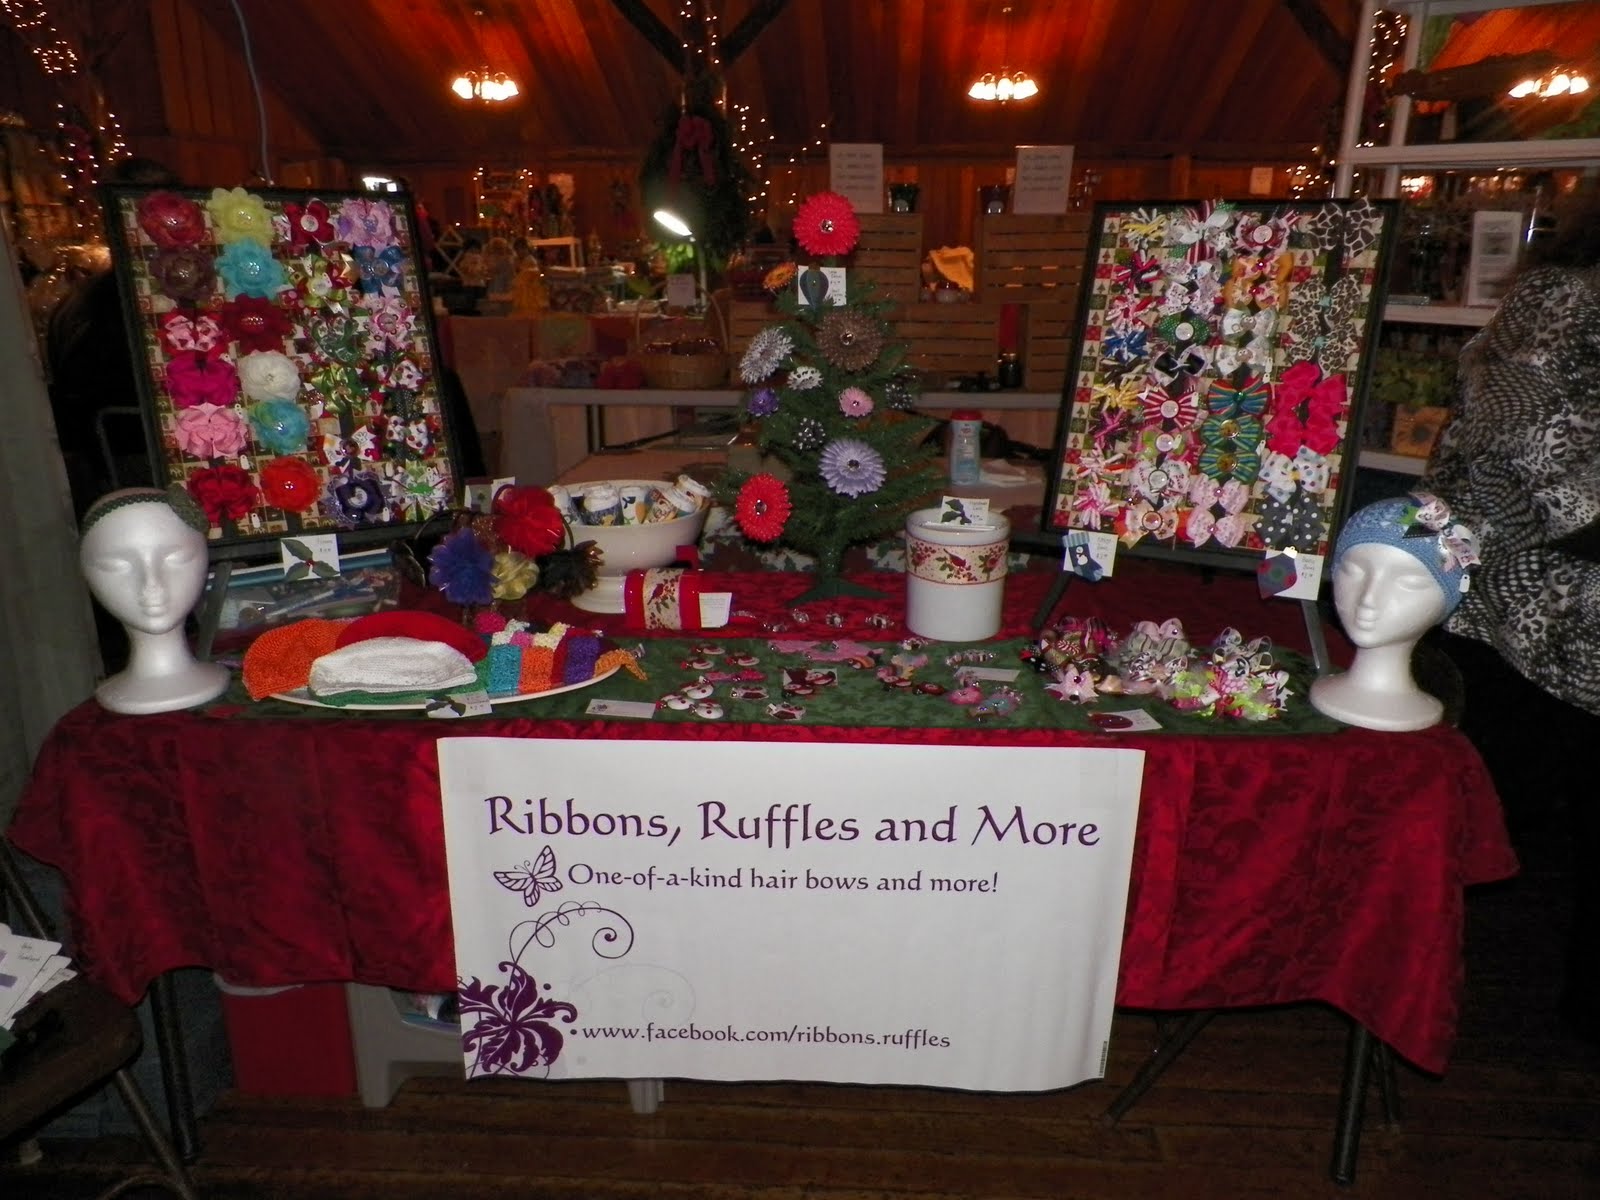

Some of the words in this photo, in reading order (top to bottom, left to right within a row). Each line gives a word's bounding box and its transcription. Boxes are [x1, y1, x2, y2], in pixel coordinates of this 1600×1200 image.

[484, 795, 681, 848] Ribbons,
[697, 801, 860, 850] Ruffles
[875, 805, 958, 843] and
[971, 805, 1100, 847] More
[568, 864, 742, 891] One-of-a-kind
[750, 868, 798, 889] hair
[805, 868, 868, 890] bows
[877, 870, 922, 892] and
[930, 871, 998, 893] more!
[583, 1022, 951, 1050] www.facebook.com/ribbons.ruffles
